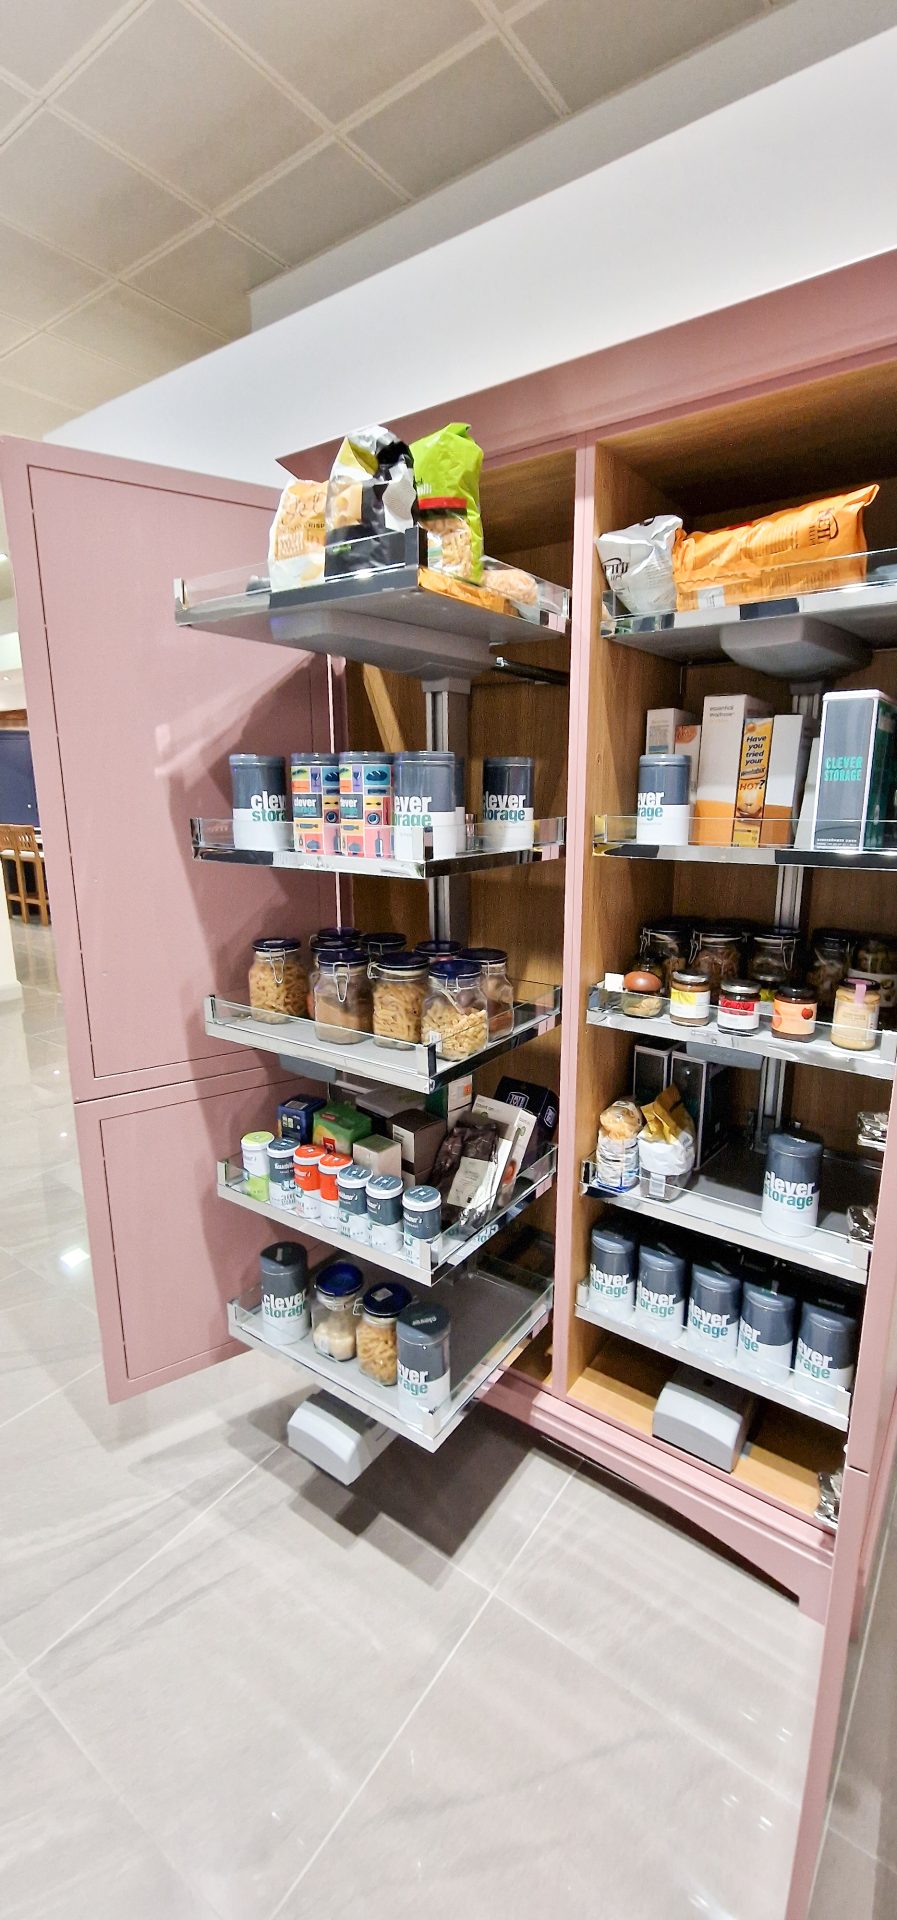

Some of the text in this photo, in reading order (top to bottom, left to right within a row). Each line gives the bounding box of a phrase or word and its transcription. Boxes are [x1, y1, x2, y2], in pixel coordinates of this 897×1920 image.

[745, 758, 764, 766] your
[825, 756, 863, 769] CLEVER
[824, 769, 862, 781] STORAGE
[251, 790, 286, 810] clev
[394, 796, 432, 812] ever
[637, 1280, 677, 1306] lever
[689, 1297, 731, 1326] lever
